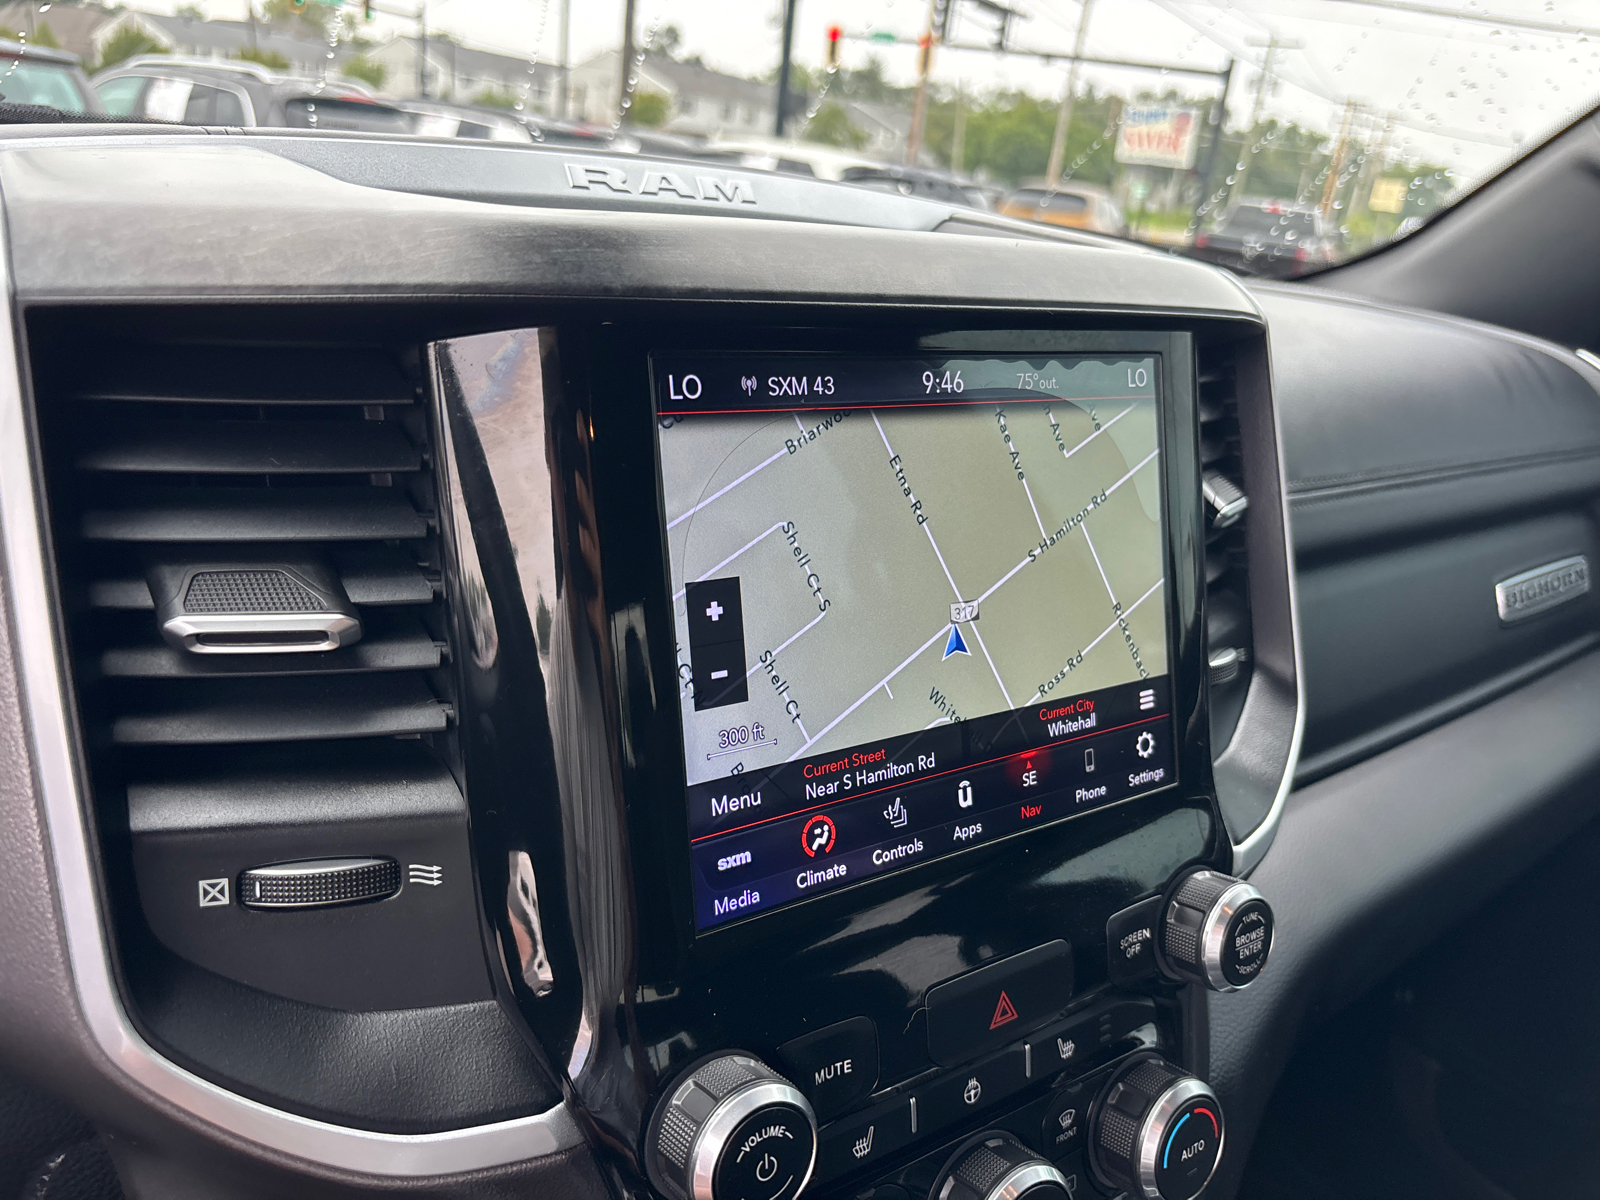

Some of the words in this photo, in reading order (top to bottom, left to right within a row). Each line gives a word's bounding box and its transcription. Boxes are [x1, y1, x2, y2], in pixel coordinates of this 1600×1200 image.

[564, 163, 757, 204] RAM
[668, 374, 702, 400] LO
[768, 377, 808, 396] SXM
[813, 376, 835, 394] 43
[922, 370, 964, 393] 9:46
[1127, 368, 1147, 387] LO
[994, 409, 1012, 444] Kae
[1009, 451, 1025, 481] Ave
[1050, 423, 1065, 452] Ave
[889, 454, 912, 497] Etna
[910, 500, 929, 526] Rd
[1028, 549, 1037, 563] S
[1038, 507, 1090, 555] Hamilton
[1091, 488, 1108, 508] Rd
[782, 521, 811, 568] Shell
[807, 573, 822, 597] Ct
[819, 599, 831, 612] S
[954, 605, 975, 621] 317
[759, 650, 790, 696] Shell
[785, 700, 801, 724] Ct
[1038, 672, 1066, 698] Ross
[1066, 651, 1083, 672] Rd
[1039, 703, 1074, 721] Current
[1076, 699, 1095, 714] City
[719, 726, 749, 749] 300
[752, 722, 765, 741] ft
[1047, 712, 1096, 738] Whitehall
[803, 759, 850, 779] Current
[852, 749, 886, 769] Street
[805, 781, 840, 800] Near
[843, 774, 853, 790] S
[856, 763, 915, 786] Hamilton
[918, 752, 936, 770] Rd
[1128, 767, 1165, 787] Settings
[1022, 771, 1038, 787] SE
[710, 791, 762, 817] Menu
[1075, 784, 1107, 803] Phone
[1021, 805, 1042, 819] Nav
[953, 822, 983, 841] Apps
[717, 851, 752, 871] sxm
[872, 838, 925, 866] Controls
[796, 862, 848, 889] Climate
[714, 889, 761, 916] Media
[1242, 911, 1259, 924] TUNE
[1119, 928, 1150, 951] SCREEN
[1235, 926, 1265, 947] BROWSE
[1125, 943, 1142, 960] OFF
[1239, 942, 1263, 960] ENTER
[815, 1059, 853, 1085] MUTE
[741, 1125, 786, 1152] VOLUME
[1055, 1127, 1077, 1145] FRONT
[1181, 1139, 1206, 1162] AUTO
